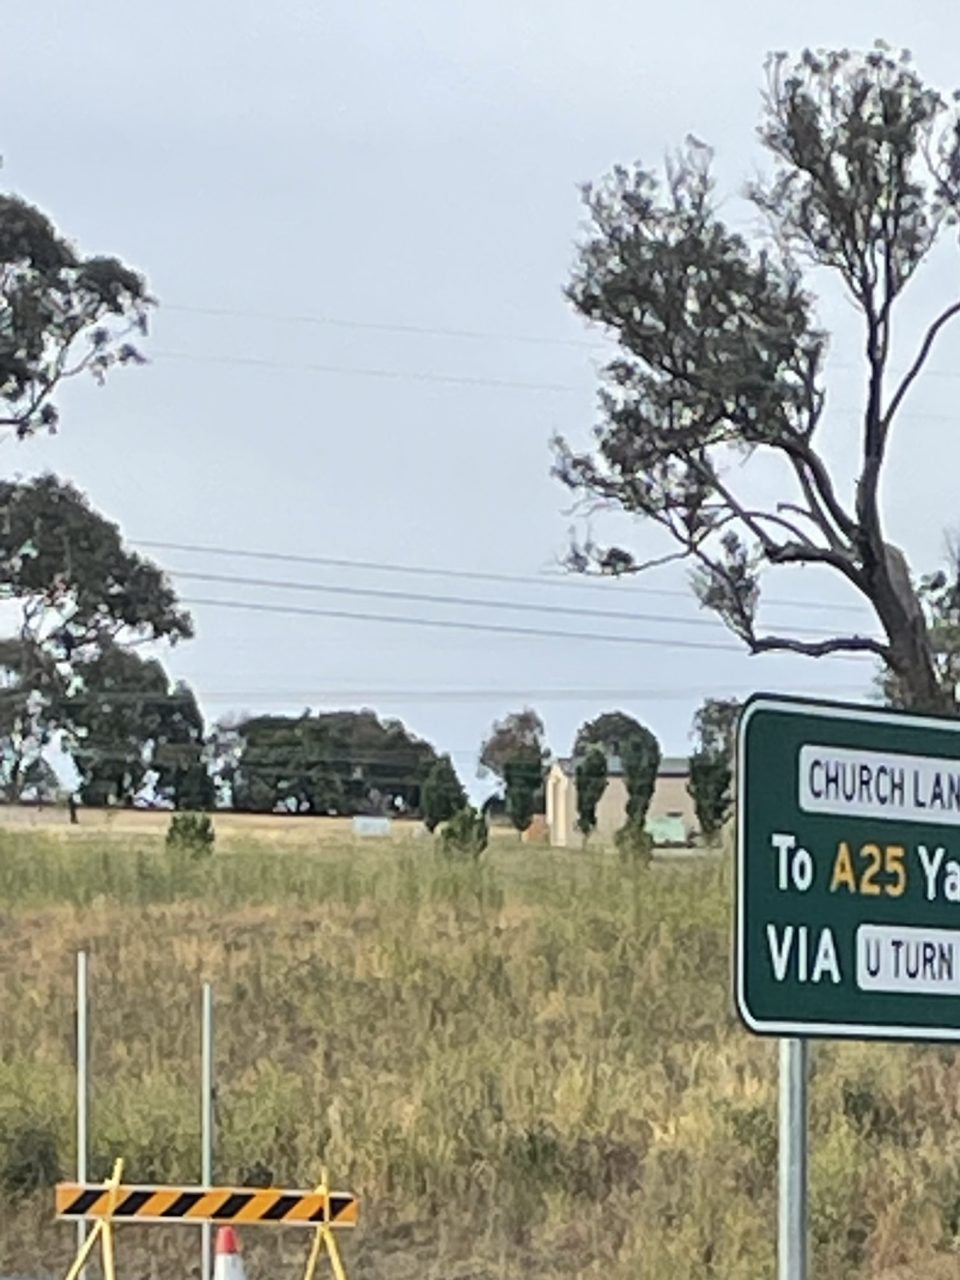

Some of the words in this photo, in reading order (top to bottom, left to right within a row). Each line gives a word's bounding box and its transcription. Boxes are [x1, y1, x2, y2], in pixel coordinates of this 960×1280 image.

[809, 759, 904, 807] CHURCH
[771, 833, 813, 892] To
[829, 841, 907, 897] A25
[766, 924, 841, 984] VIA
[865, 940, 881, 977] U
[891, 940, 954, 981] TURN
